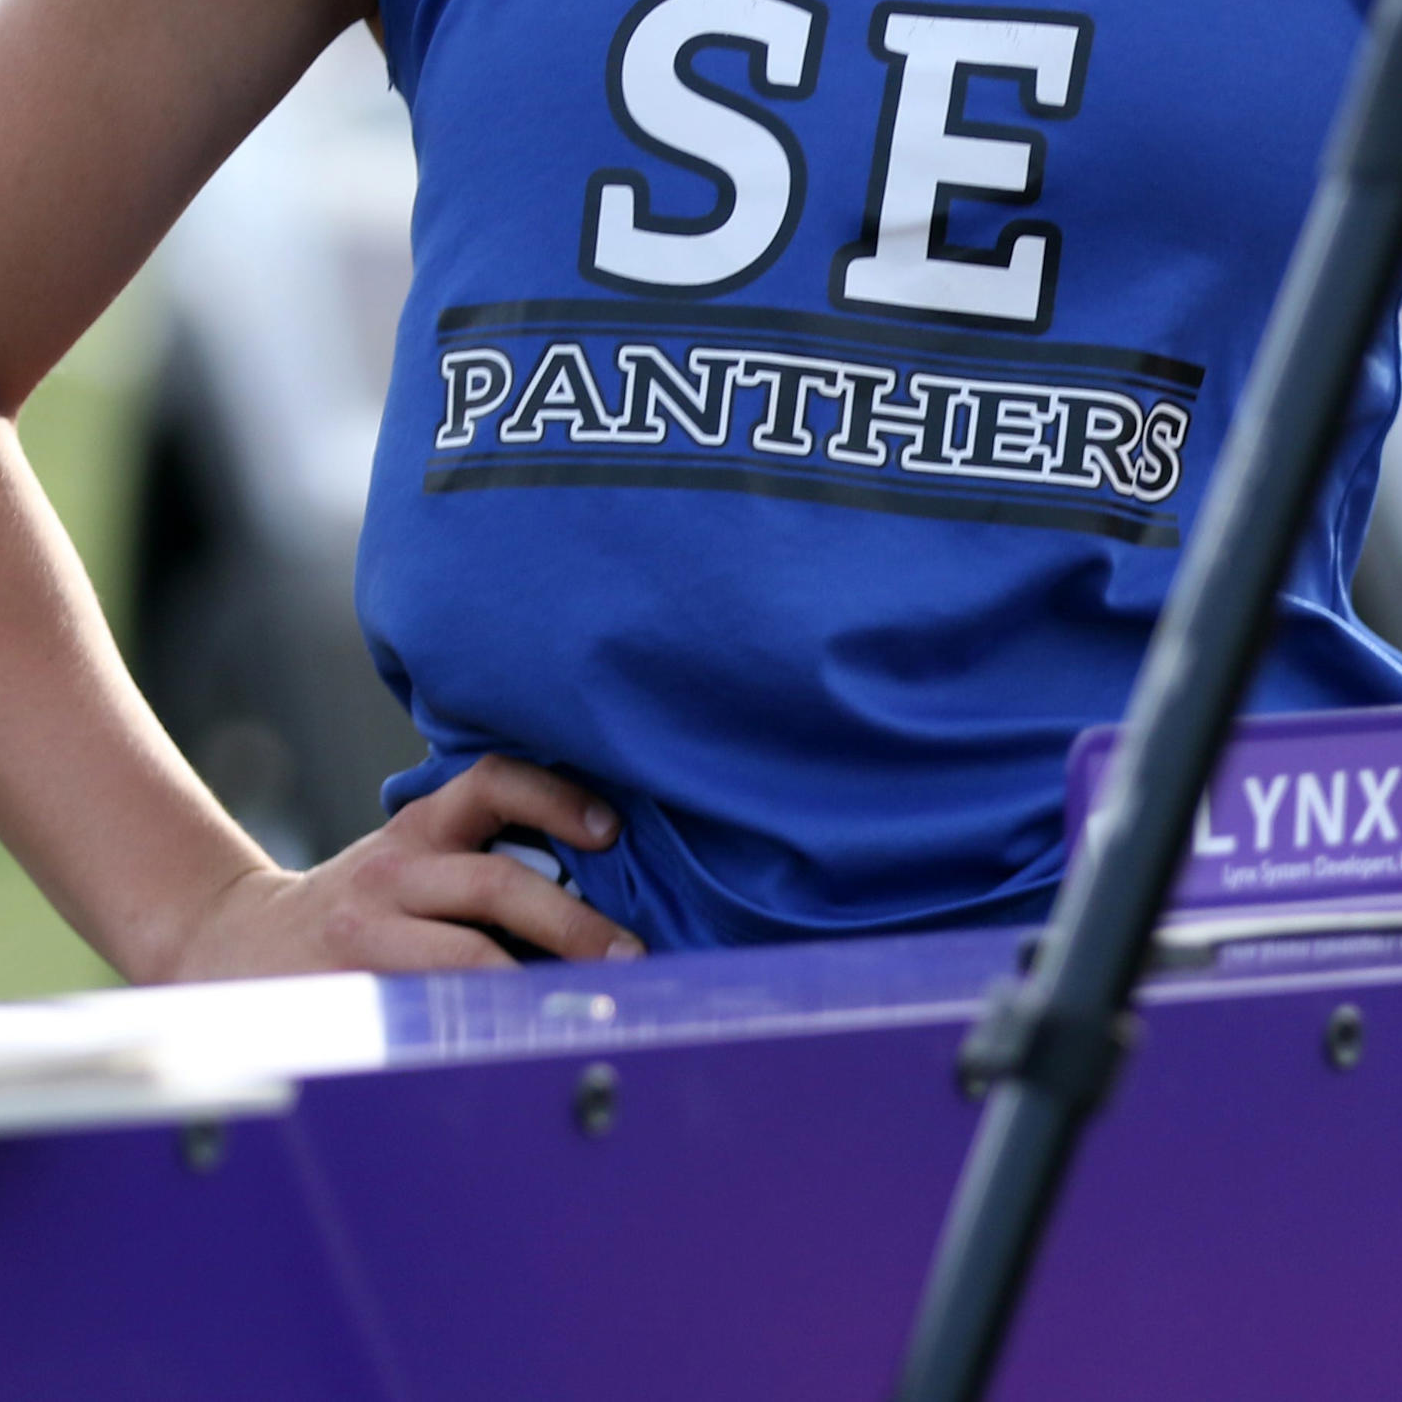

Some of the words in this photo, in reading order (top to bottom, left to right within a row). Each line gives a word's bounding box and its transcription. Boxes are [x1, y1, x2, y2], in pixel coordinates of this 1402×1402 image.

[435, 342, 1190, 503] PANTHERS
[1192, 765, 1402, 857] LYNX
[1222, 862, 1258, 890] Lynx
[1261, 858, 1312, 887] System
